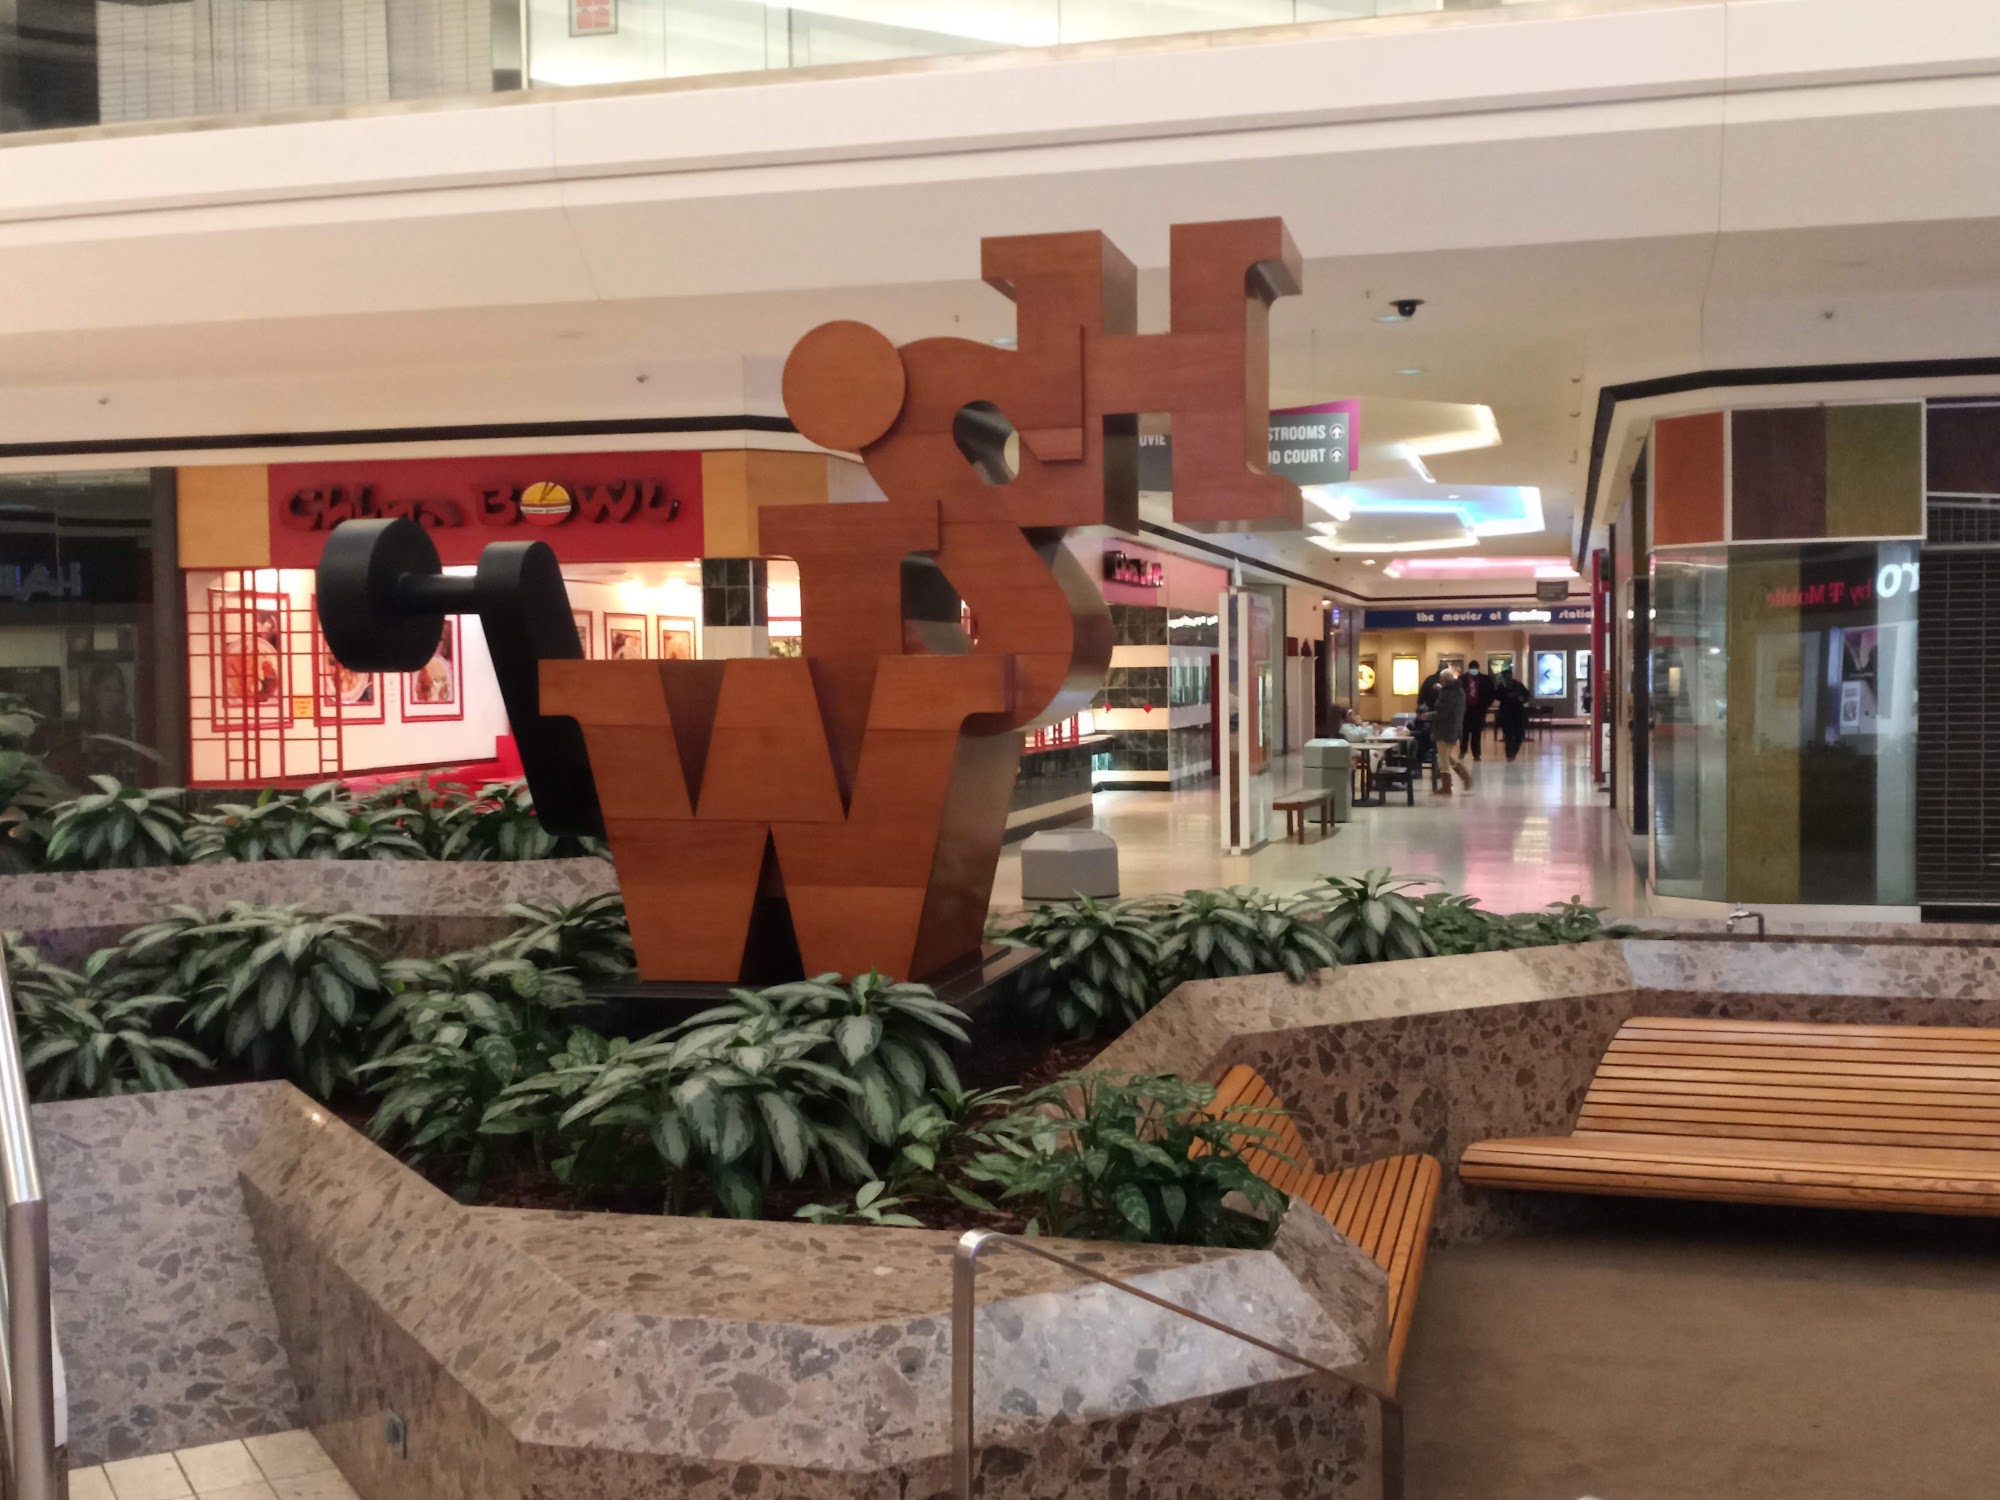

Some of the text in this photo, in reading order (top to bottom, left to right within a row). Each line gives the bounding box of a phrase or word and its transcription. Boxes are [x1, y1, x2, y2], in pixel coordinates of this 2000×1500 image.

[1283, 448, 1326, 464] COURT
[1416, 611, 1435, 622] the
[1441, 611, 1483, 622] movies
[1489, 611, 1502, 621] at
[1558, 609, 1592, 619] statio
